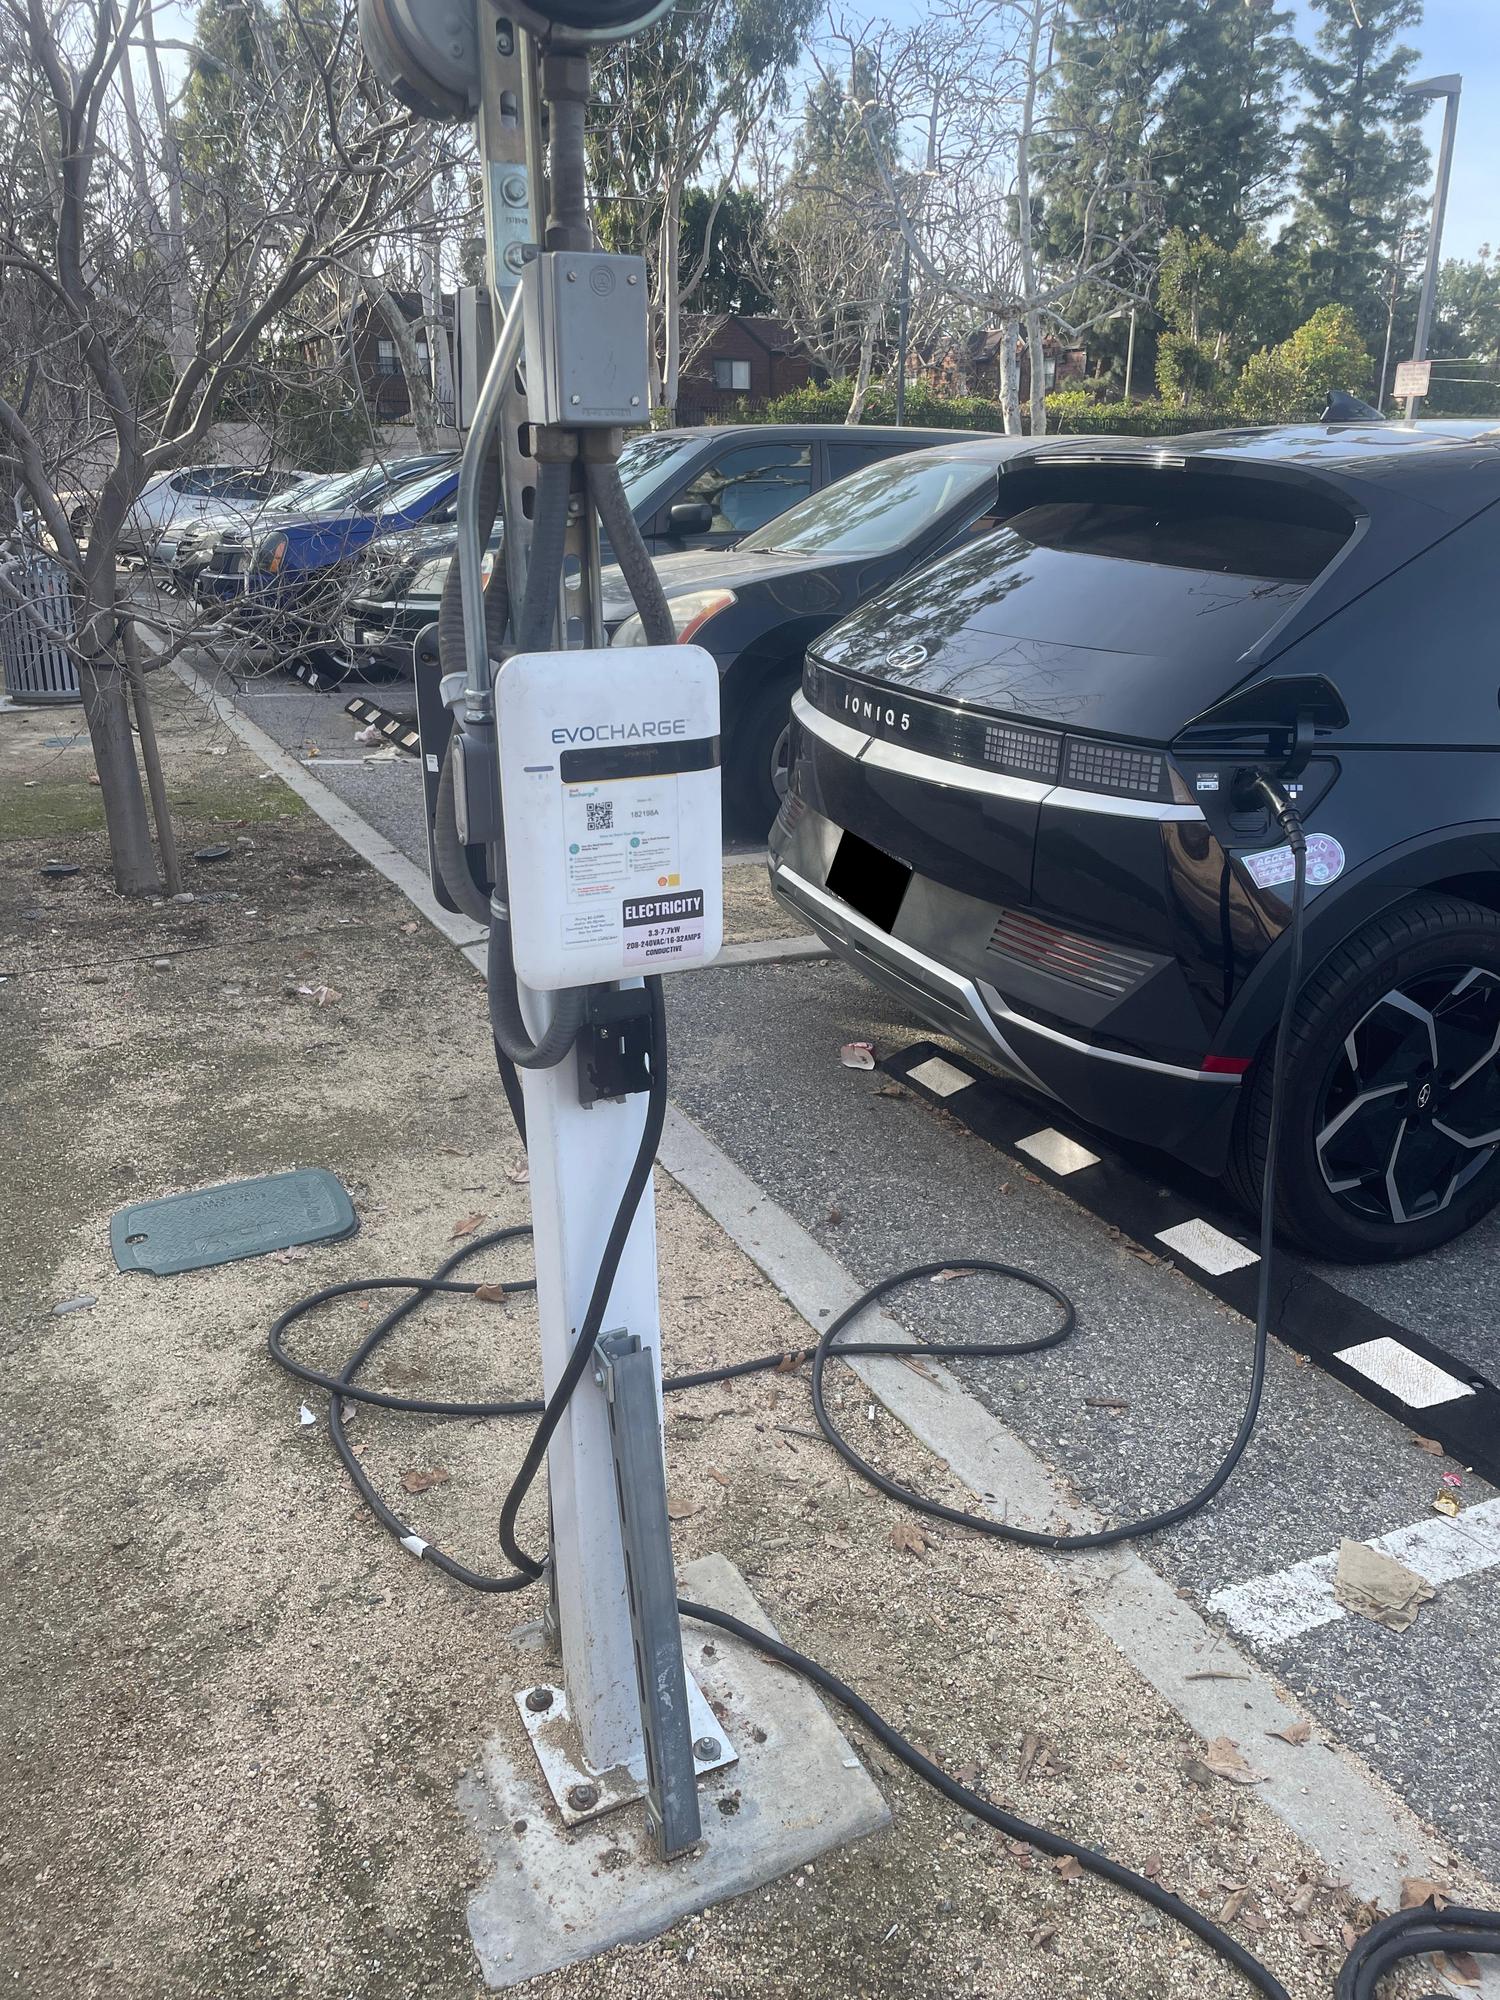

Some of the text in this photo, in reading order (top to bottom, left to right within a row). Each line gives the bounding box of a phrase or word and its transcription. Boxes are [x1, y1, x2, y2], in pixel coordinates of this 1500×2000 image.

[845, 694, 910, 731] IONIQ 5
[552, 719, 686, 744] EVOCHARGE
[1256, 852, 1293, 866] ACCES
[625, 897, 701, 920] ELECTRICITY
[645, 945, 682, 956] CONDUCTIVE
